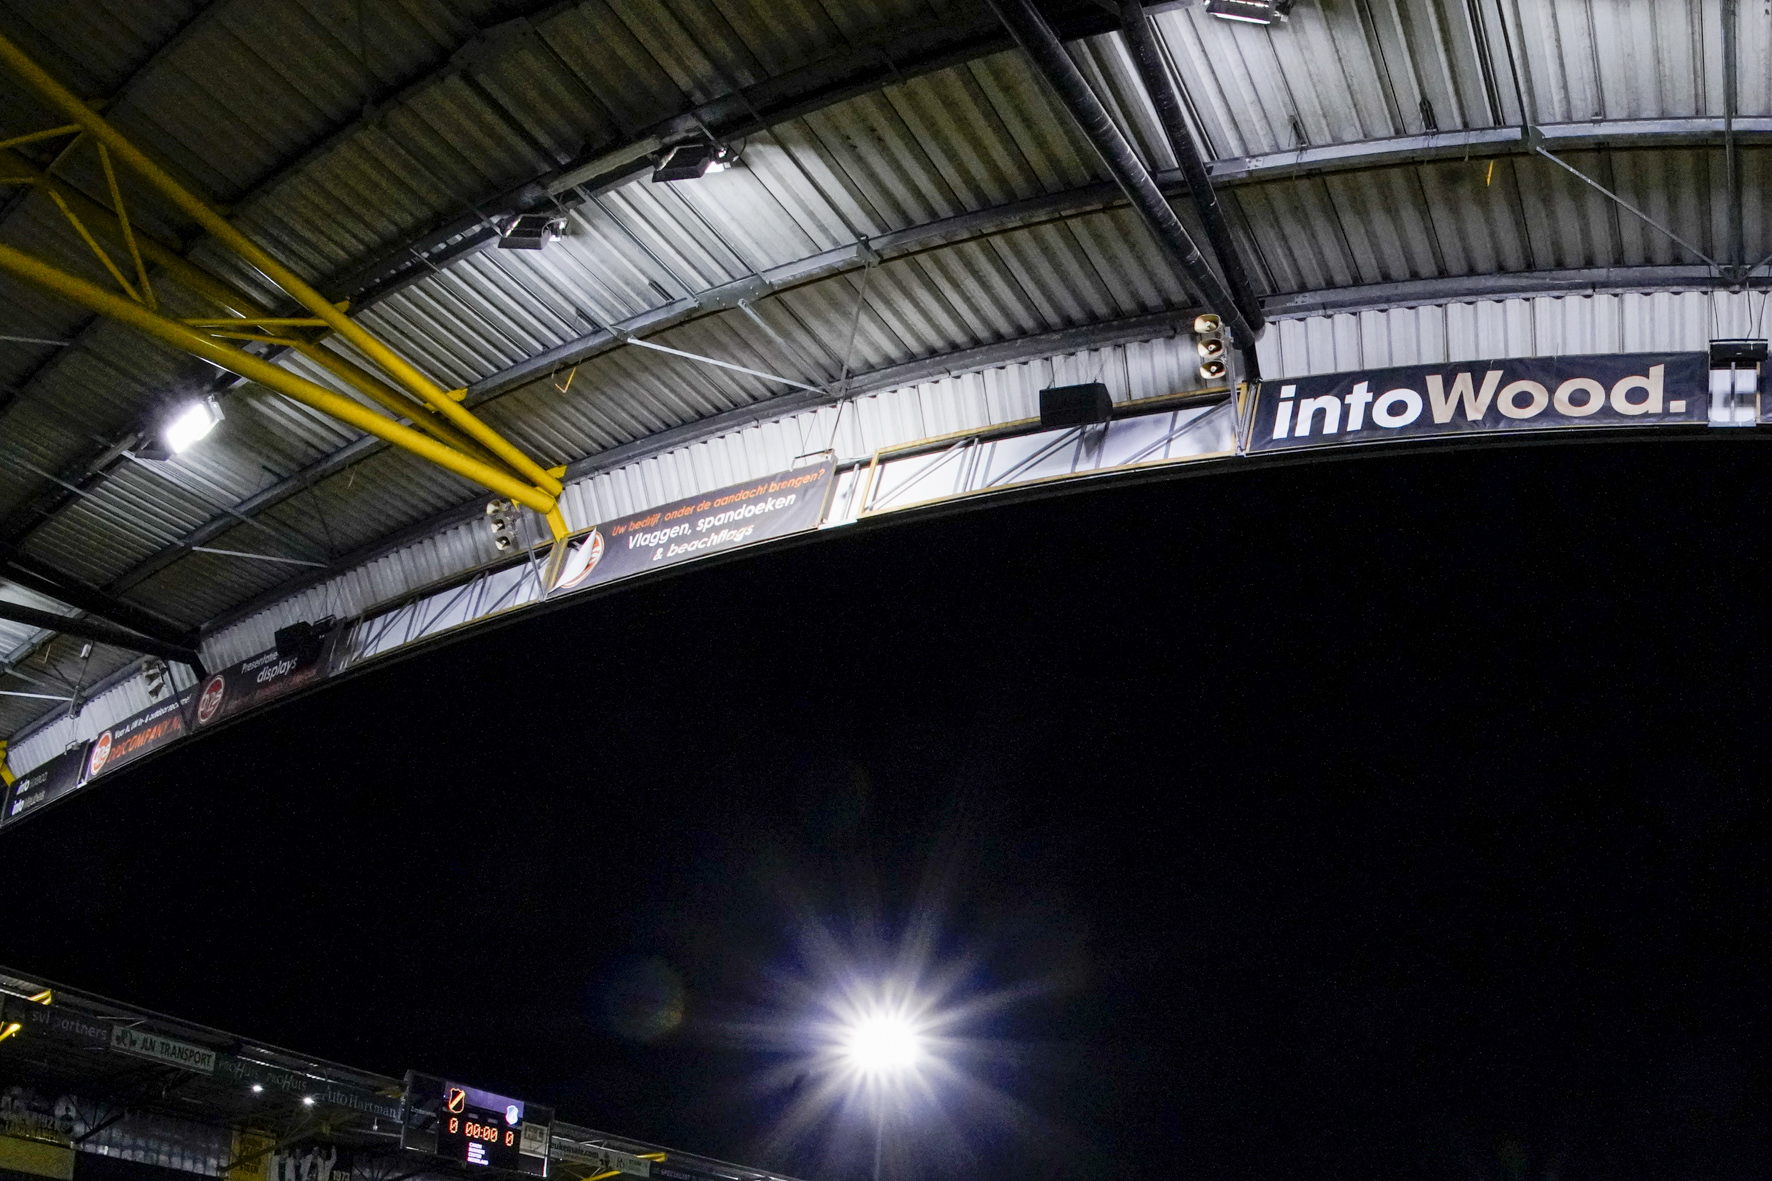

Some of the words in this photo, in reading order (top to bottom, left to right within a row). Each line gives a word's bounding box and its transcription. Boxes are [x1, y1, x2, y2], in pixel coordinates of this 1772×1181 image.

[1272, 362, 1688, 441] intoWood.
[664, 505, 695, 522] onder
[696, 500, 711, 512] de
[713, 486, 767, 508] aandacht
[768, 468, 826, 492] brengen?
[628, 521, 692, 551] Vlaggen,
[696, 493, 797, 532] spandoeken
[652, 547, 664, 562] &
[666, 523, 755, 558] beachflags
[256, 656, 298, 684] displays
[160, 1039, 213, 1067] TRANSPORT
[449, 1117, 459, 1134] 0
[464, 1121, 498, 1143] 00:00
[504, 1130, 515, 1147] 0
